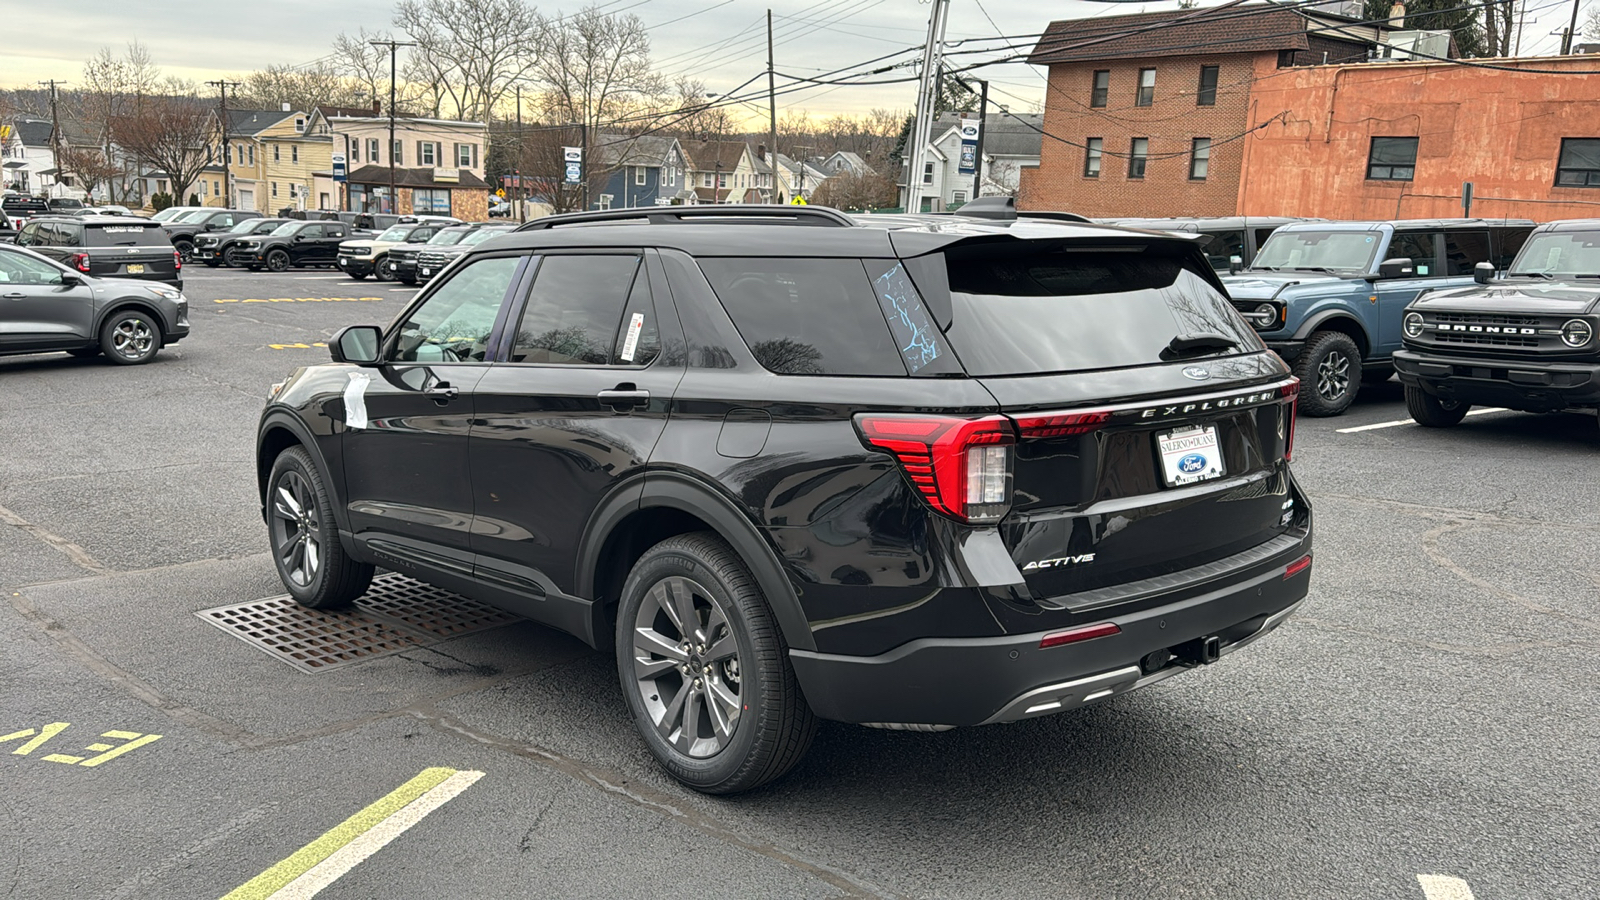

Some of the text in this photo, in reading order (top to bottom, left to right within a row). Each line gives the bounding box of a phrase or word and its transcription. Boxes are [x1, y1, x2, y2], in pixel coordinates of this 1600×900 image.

[1438, 324, 1535, 335] BRONCO
[1192, 367, 1207, 375] Ford
[1141, 391, 1274, 418] EXPLORER
[1161, 434, 1216, 453] SALERNO DUANE
[1183, 456, 1203, 472] Ford
[1022, 553, 1096, 571] ACTIVE
